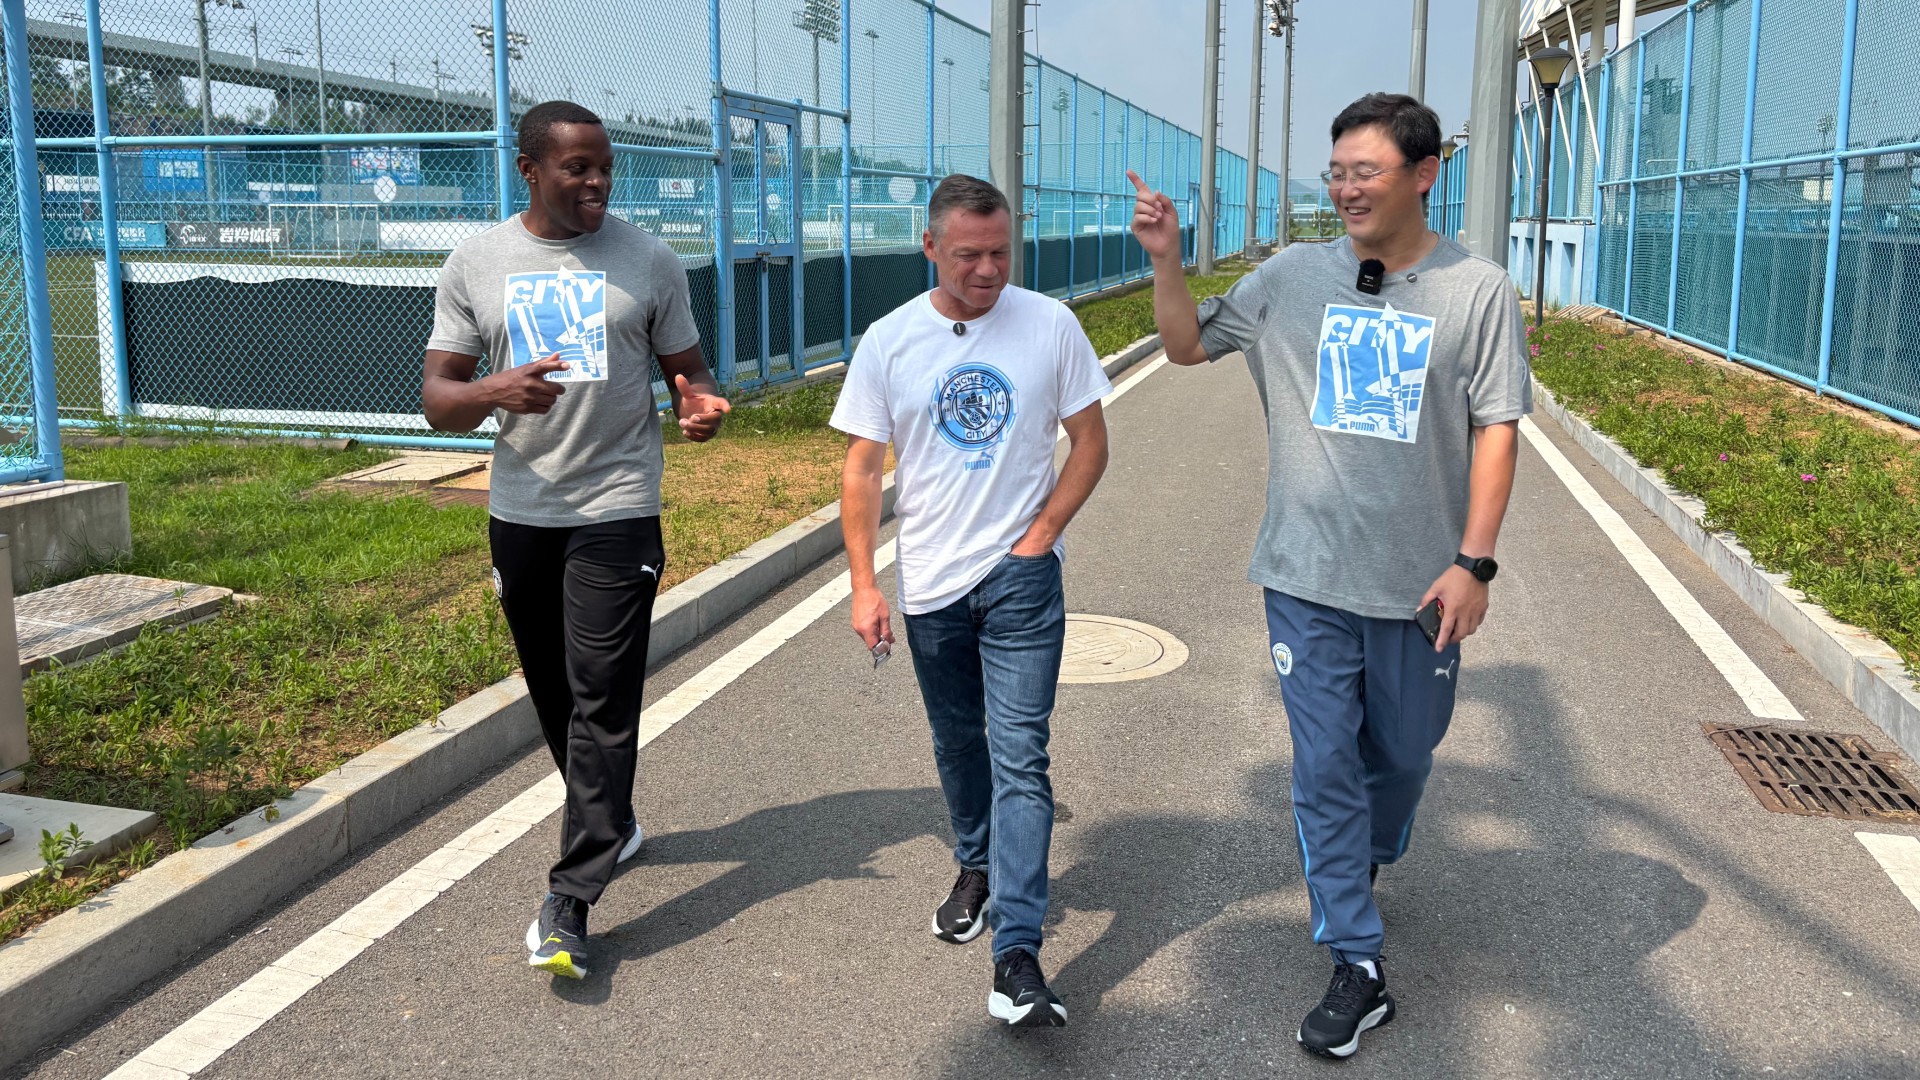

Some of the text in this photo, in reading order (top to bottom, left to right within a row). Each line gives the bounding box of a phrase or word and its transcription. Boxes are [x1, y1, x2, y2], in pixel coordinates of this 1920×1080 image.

[505, 279, 604, 304] CITY
[1320, 314, 1432, 354] CITY
[945, 374, 1001, 401] MANCHESTER
[966, 431, 987, 439] CITY
[1349, 421, 1376, 432] PUMA
[965, 460, 991, 471] PUMA
